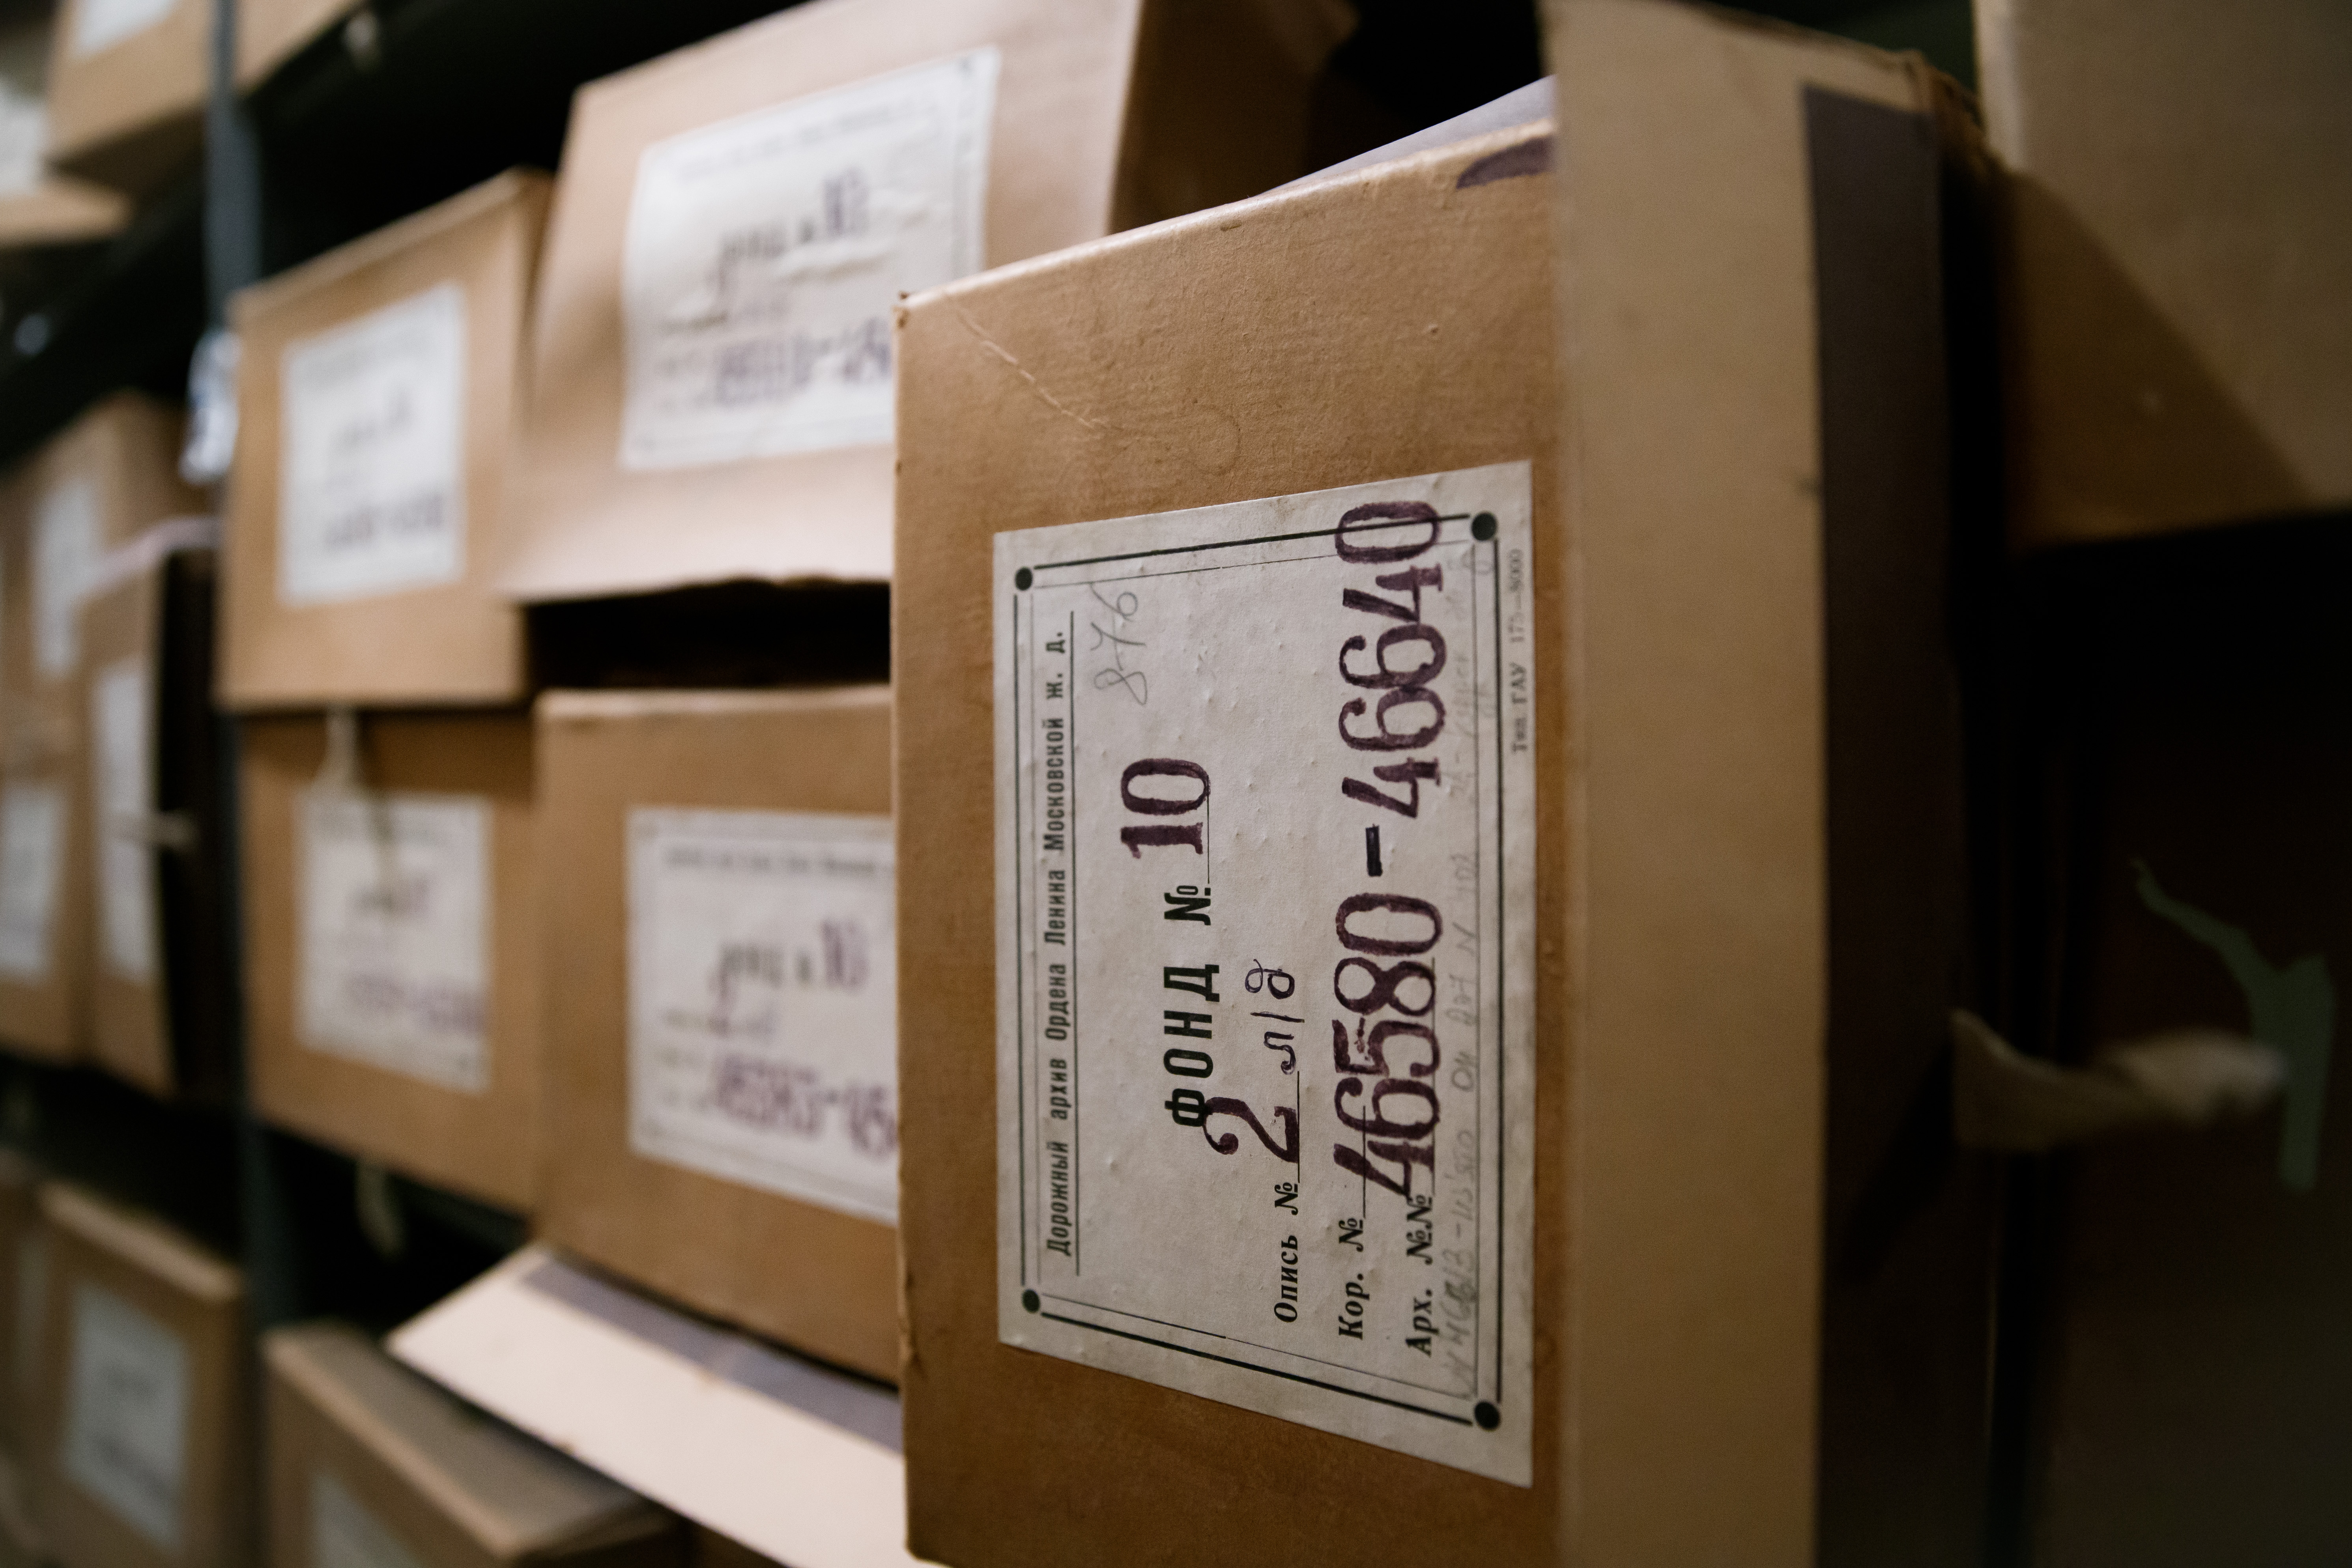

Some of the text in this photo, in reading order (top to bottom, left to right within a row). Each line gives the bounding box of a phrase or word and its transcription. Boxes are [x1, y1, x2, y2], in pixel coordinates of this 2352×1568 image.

[1120, 757, 1210, 859] 10
[1041, 631, 1072, 1257] Дорожный архив Ордена Ленина Московской ж. д.
[1163, 963, 1220, 1127] ФОНД
[1202, 1096, 1299, 1163] 2
[1273, 1181, 1298, 1216] №
[1273, 1234, 1298, 1323] Опись
[1338, 1217, 1370, 1340] Кор. №
[1404, 1288, 1440, 1358] Арх.
